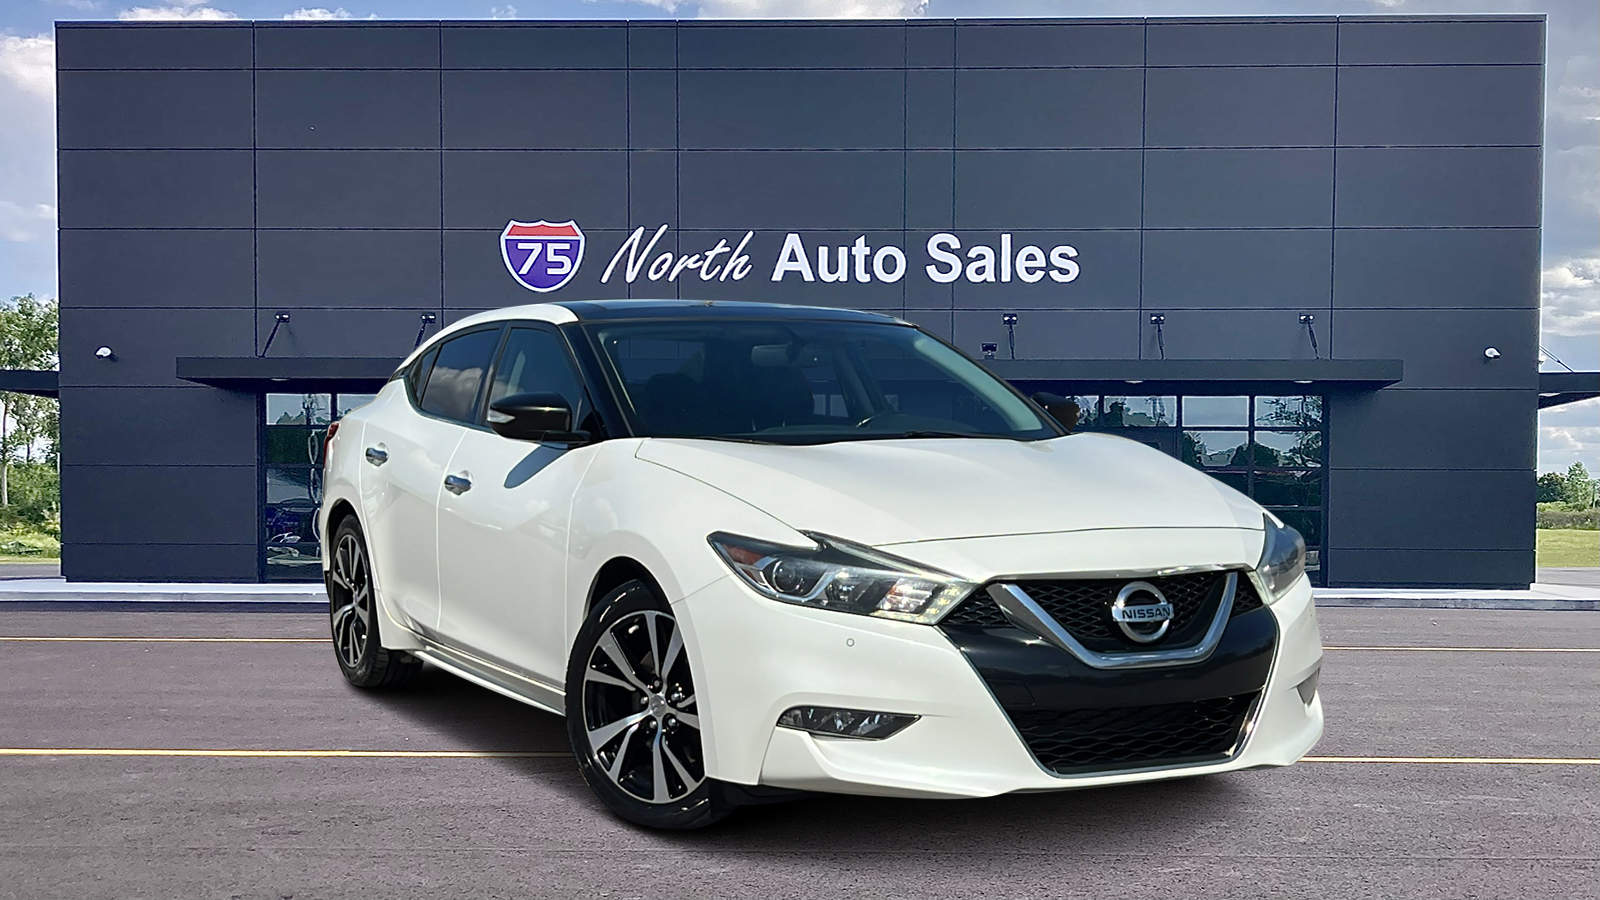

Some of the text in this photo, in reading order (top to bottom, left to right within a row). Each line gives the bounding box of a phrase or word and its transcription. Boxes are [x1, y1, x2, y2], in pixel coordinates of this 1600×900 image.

[517, 224, 1080, 283] 75 North Auto Sales
[1122, 607, 1170, 619] NISSAN
